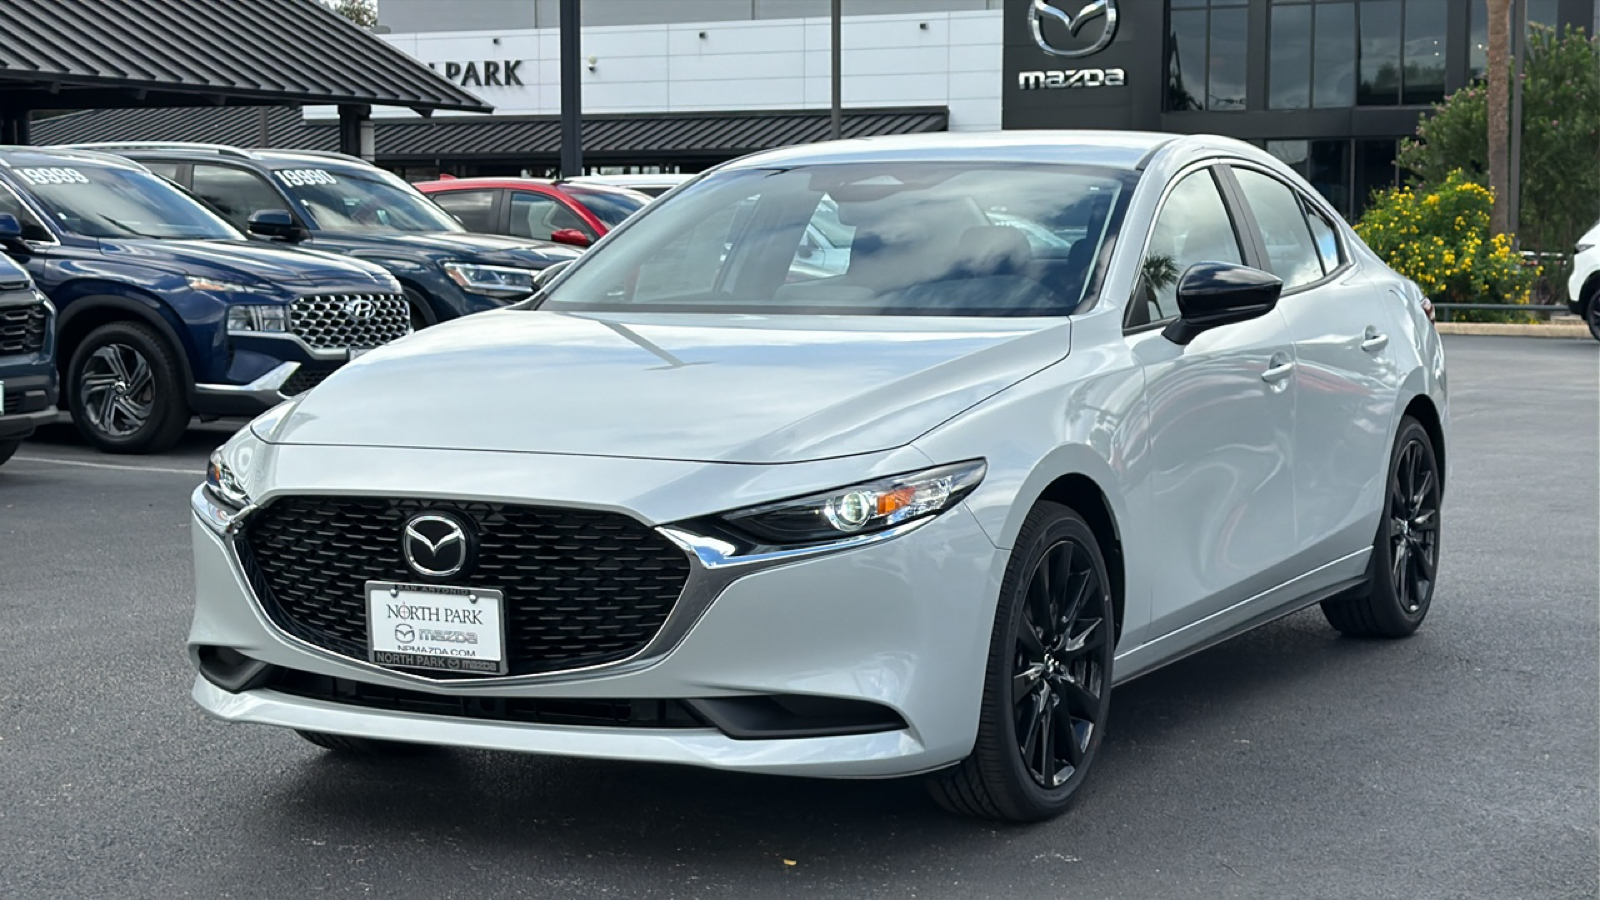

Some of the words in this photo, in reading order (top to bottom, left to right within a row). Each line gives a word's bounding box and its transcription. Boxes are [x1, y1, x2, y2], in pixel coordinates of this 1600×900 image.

[445, 60, 524, 86] PARK
[1018, 68, 1125, 89] mazda
[13, 168, 90, 185] 19999
[274, 169, 337, 188] 19990
[386, 603, 441, 622] NORTH
[444, 606, 484, 625] PARK
[419, 628, 479, 645] mazda
[377, 652, 413, 665] NORTH
[417, 655, 446, 668] PARK
